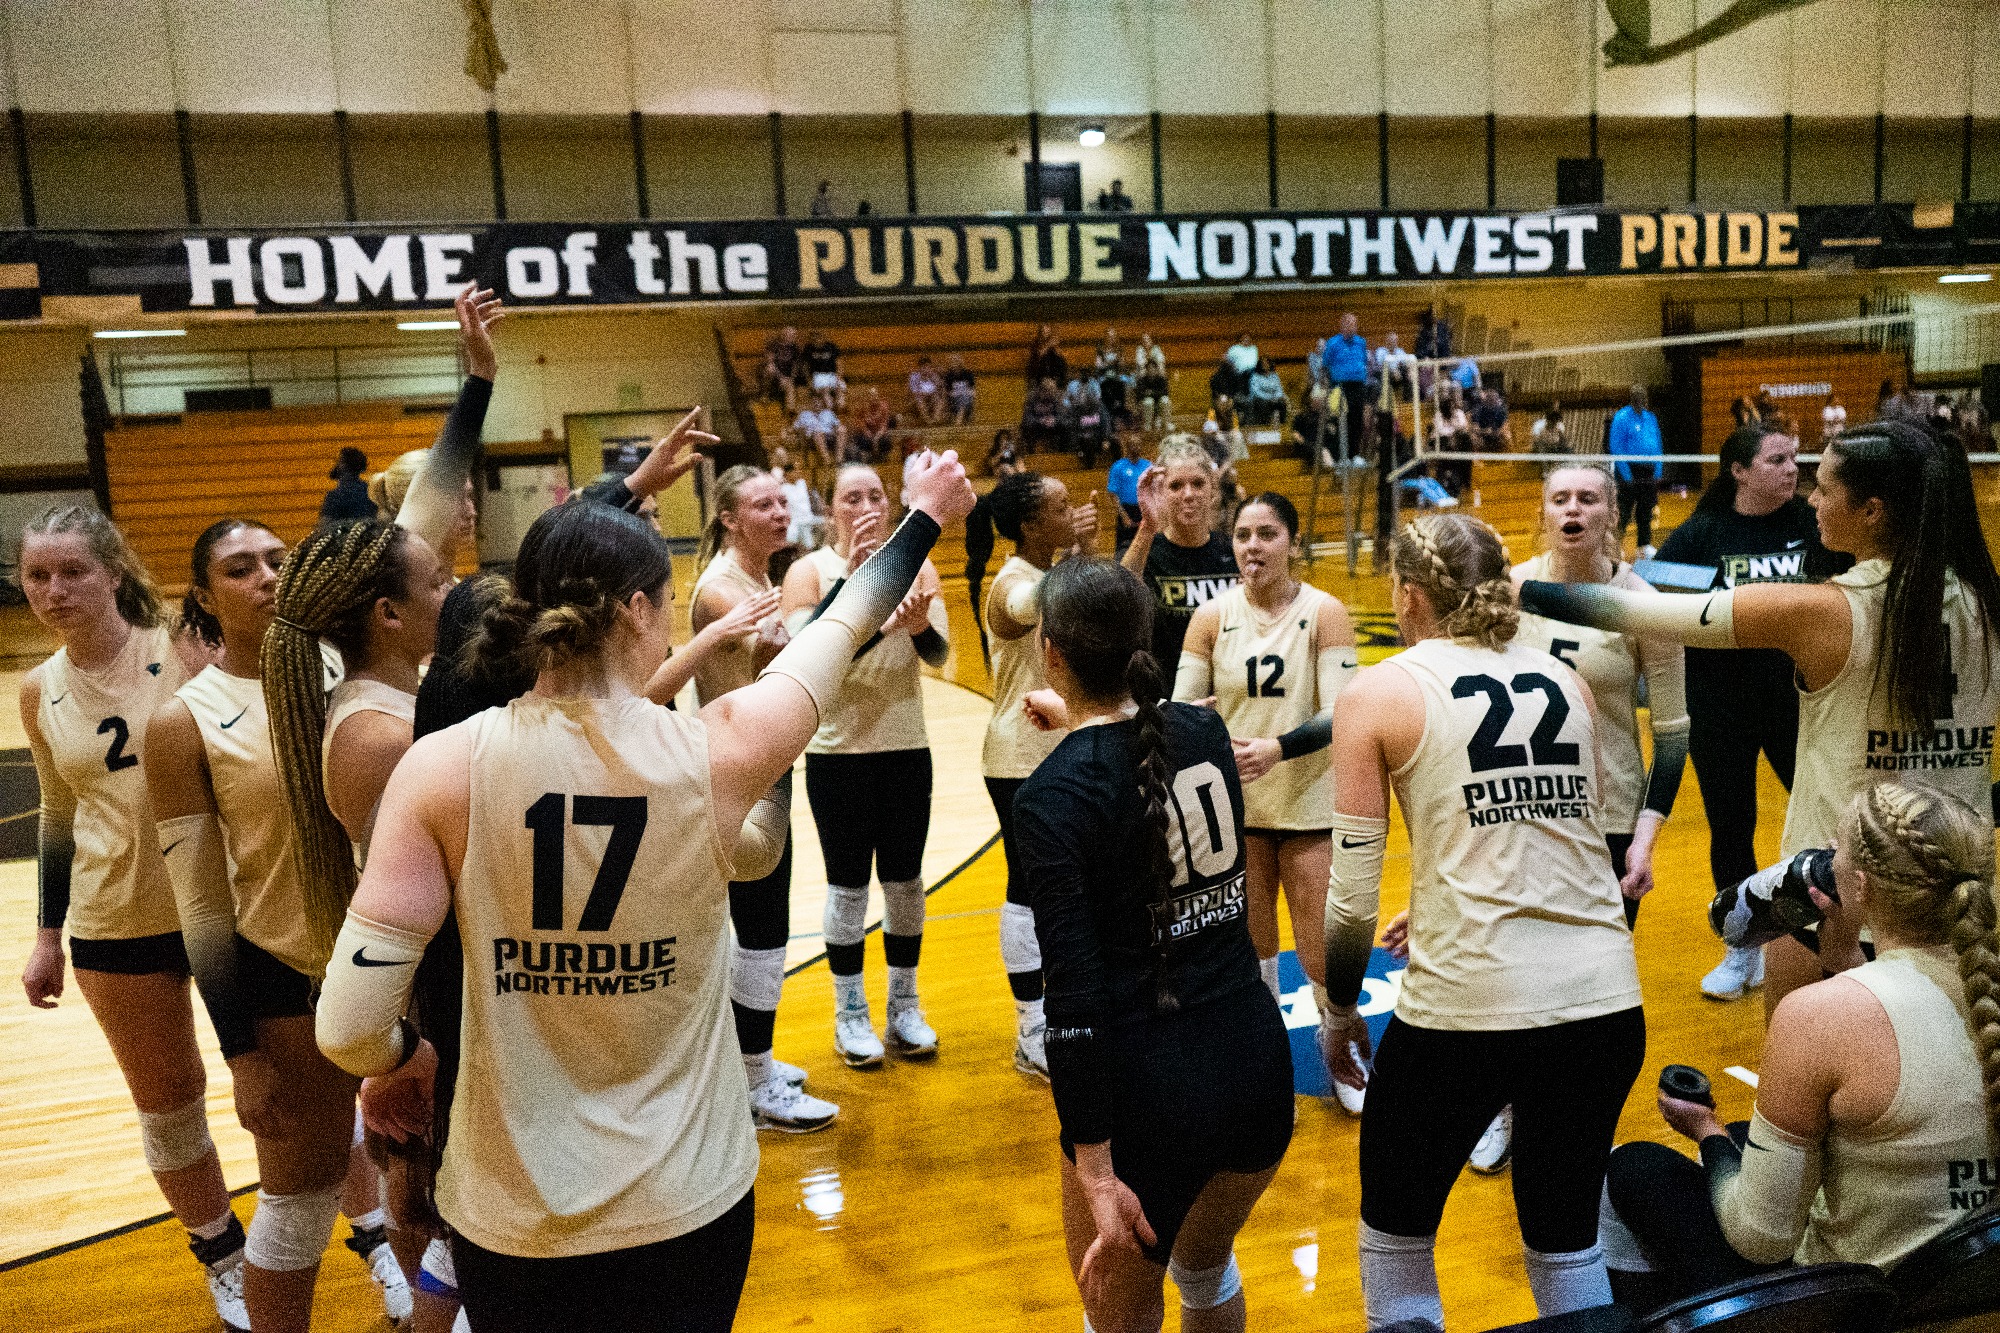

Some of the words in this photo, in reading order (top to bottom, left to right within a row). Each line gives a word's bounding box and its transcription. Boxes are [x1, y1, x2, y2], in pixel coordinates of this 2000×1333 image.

[183, 233, 477, 308] HOME
[506, 231, 597, 299] of
[627, 228, 769, 295] the
[796, 222, 1123, 291] PURDUE
[1146, 214, 1598, 282] NORTHWEST
[1619, 211, 1800, 270] PRIDE
[1729, 553, 1802, 579] PNW
[1245, 654, 1285, 698] 12
[1450, 672, 1581, 773] 22
[96, 715, 139, 773] 2
[1866, 750, 1993, 771] NORTHWEST
[1461, 774, 1588, 810] PURDUE
[1468, 802, 1590, 828] NORTHWEST
[525, 792, 648, 932] 17
[492, 936, 677, 974] PURDUE
[495, 967, 676, 996] NORTHWEST
